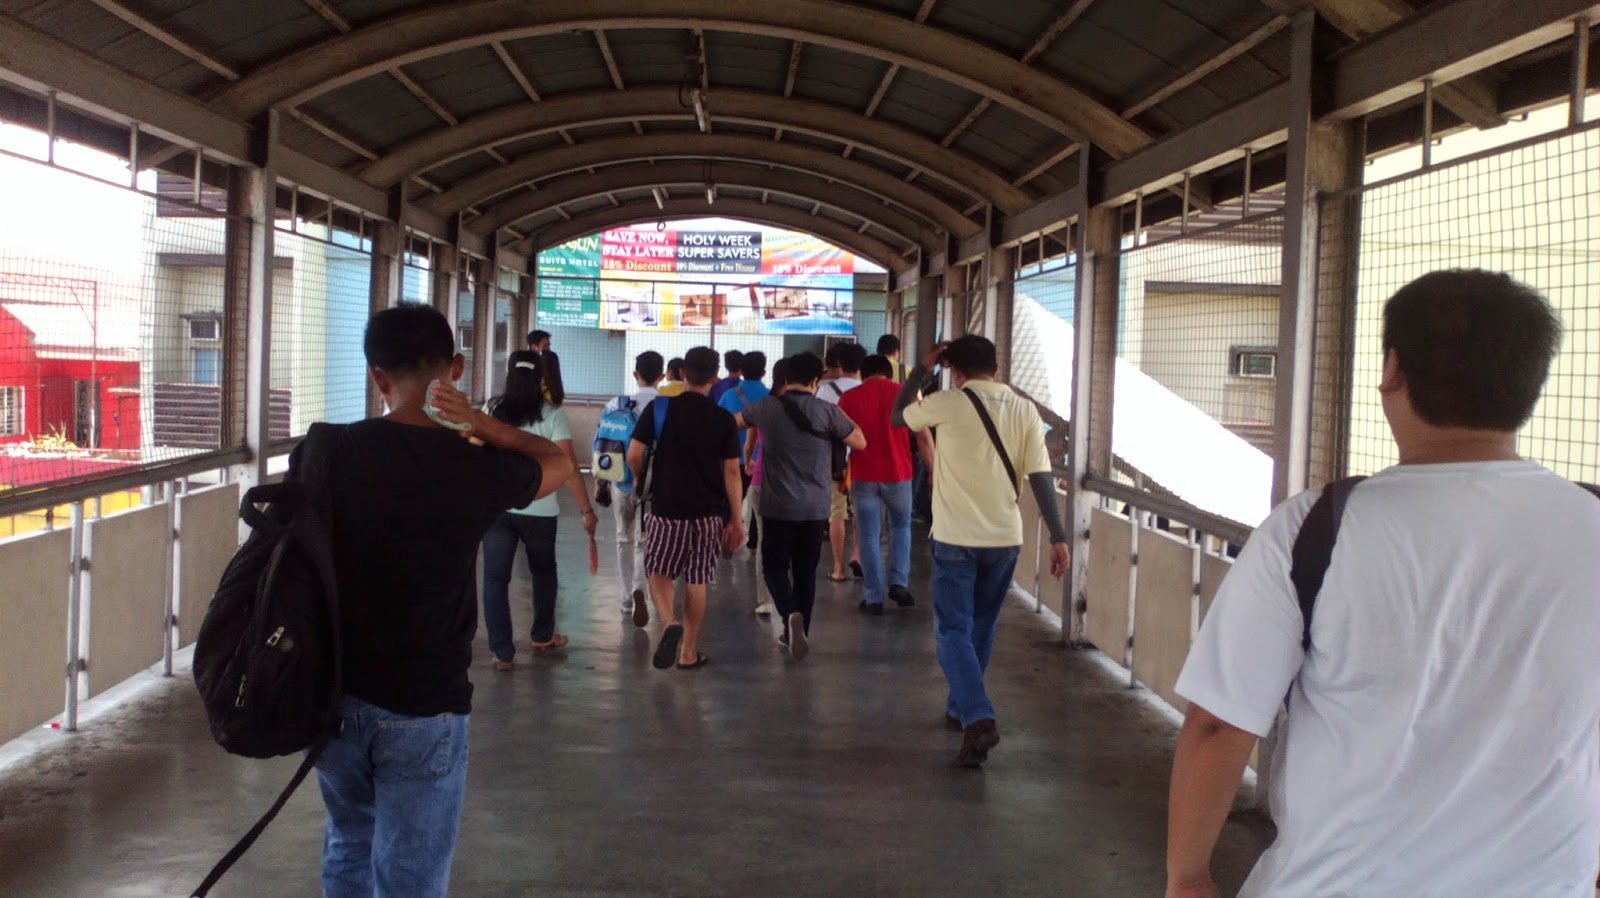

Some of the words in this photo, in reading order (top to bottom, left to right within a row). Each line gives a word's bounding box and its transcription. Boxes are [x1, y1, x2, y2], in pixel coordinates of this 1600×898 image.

[605, 231, 636, 243] SAVE
[638, 231, 669, 245] NOW,
[683, 234, 716, 246] HOLY
[719, 235, 752, 246] WEEK
[602, 245, 633, 257] STAY
[635, 246, 674, 258] LATER
[678, 247, 714, 259] SUPER
[717, 248, 760, 259] SAVERS
[539, 256, 566, 265] SUITE
[568, 258, 599, 268] HOTEL
[626, 260, 672, 272] Discount
[688, 261, 714, 272] Discount
[721, 262, 734, 272] Free
[735, 263, 756, 273] Dinner
[795, 264, 842, 274] Discount
